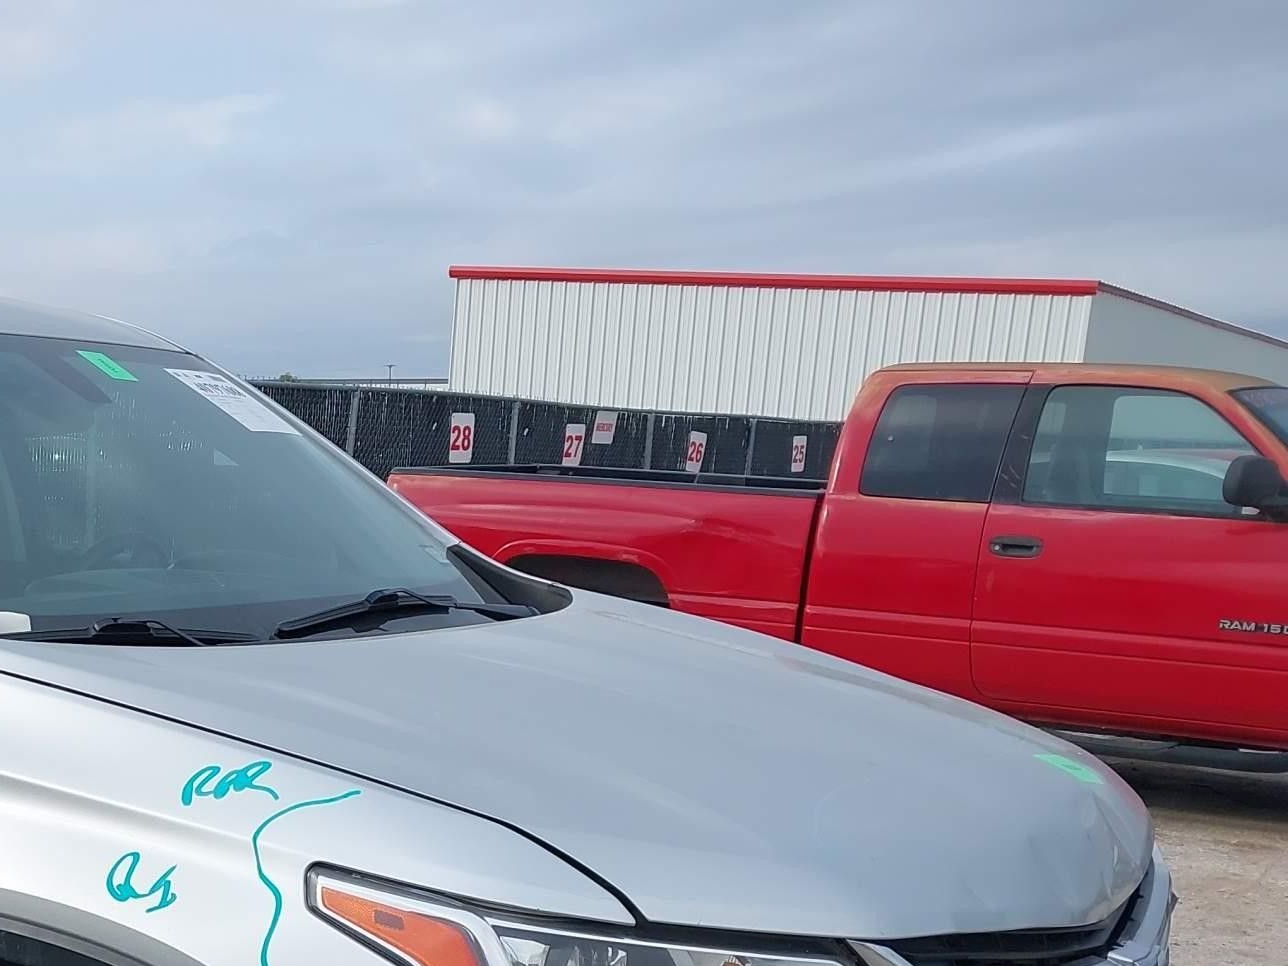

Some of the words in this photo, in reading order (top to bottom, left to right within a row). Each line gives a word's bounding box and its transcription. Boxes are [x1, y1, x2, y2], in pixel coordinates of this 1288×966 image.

[450, 424, 472, 452] 28
[563, 434, 583, 458] 27
[687, 440, 704, 463] 26
[792, 445, 805, 463] 25
[1219, 619, 1256, 632] RAM
